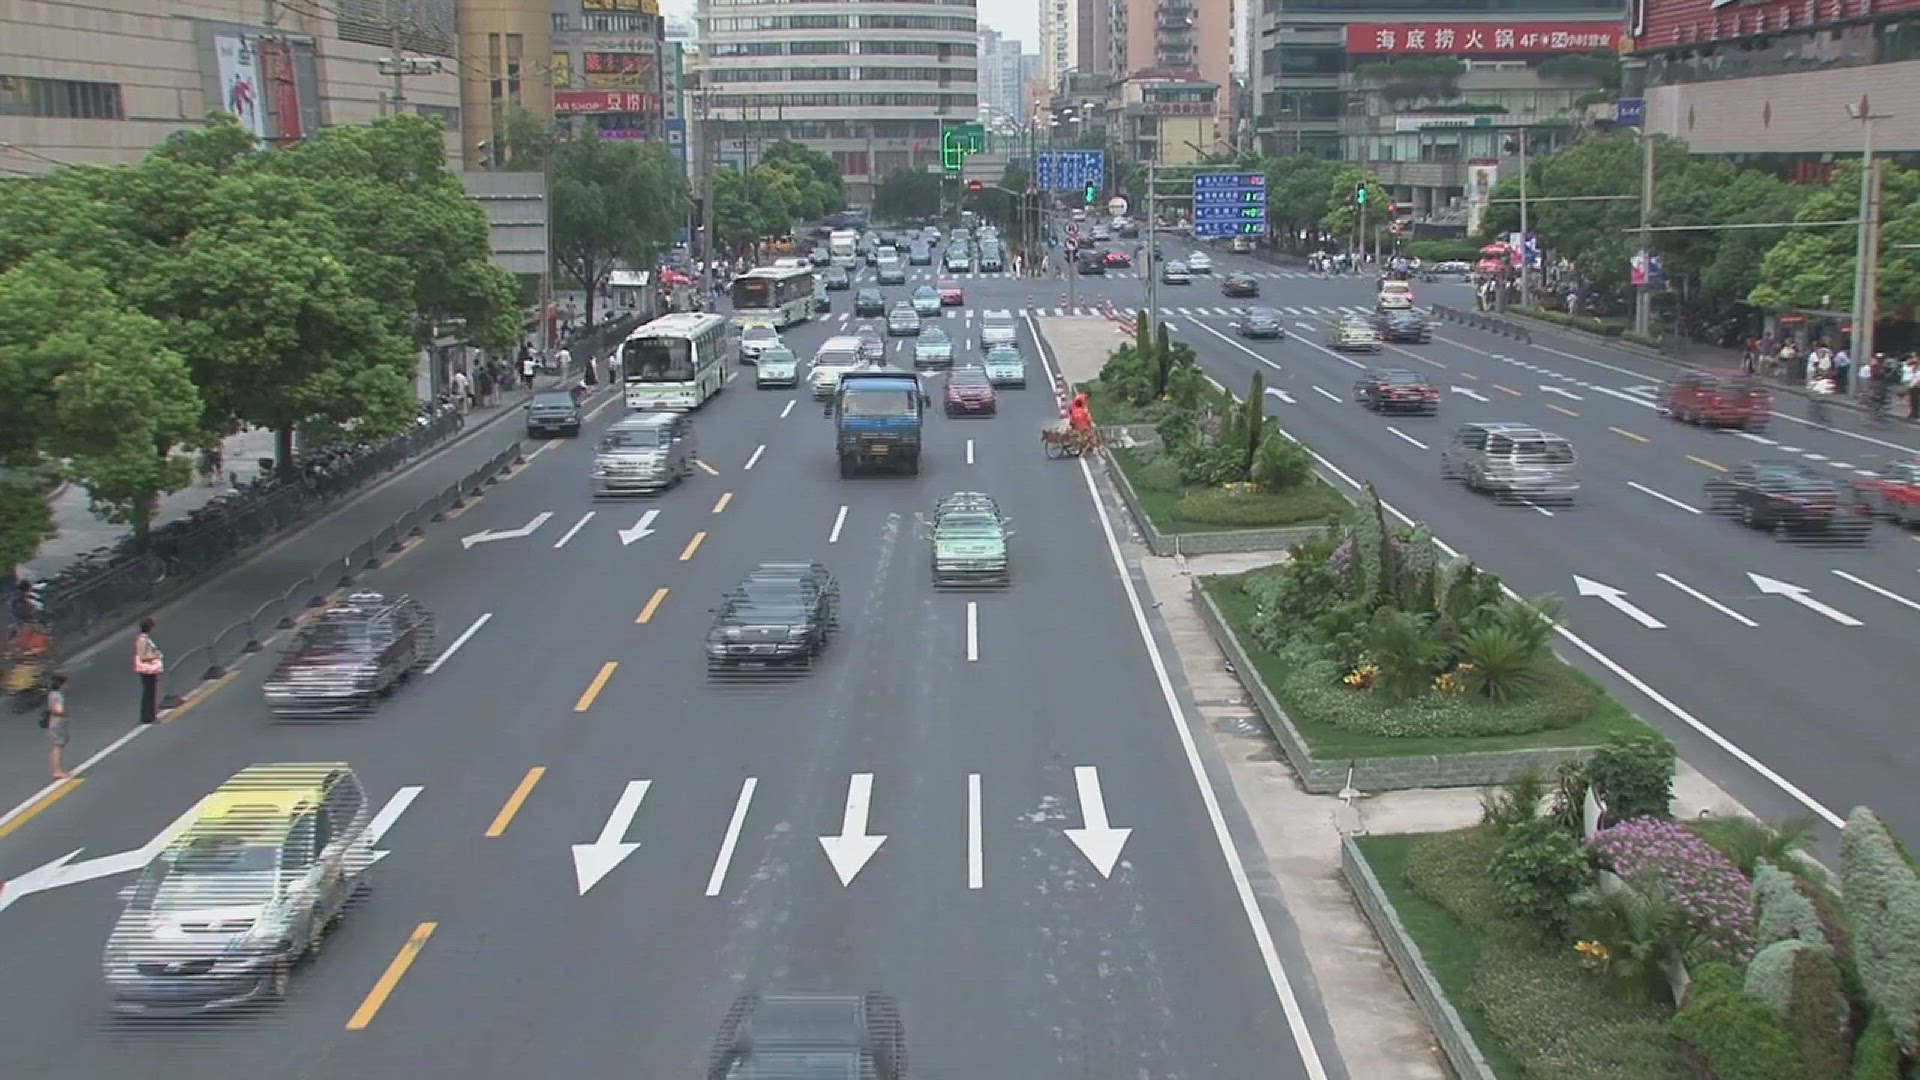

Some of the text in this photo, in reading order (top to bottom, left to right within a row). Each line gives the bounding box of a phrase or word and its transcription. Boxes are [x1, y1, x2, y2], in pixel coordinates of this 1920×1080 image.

[1376, 28, 1514, 50] 海底捞火锅
[1520, 33, 1538, 47] 4F
